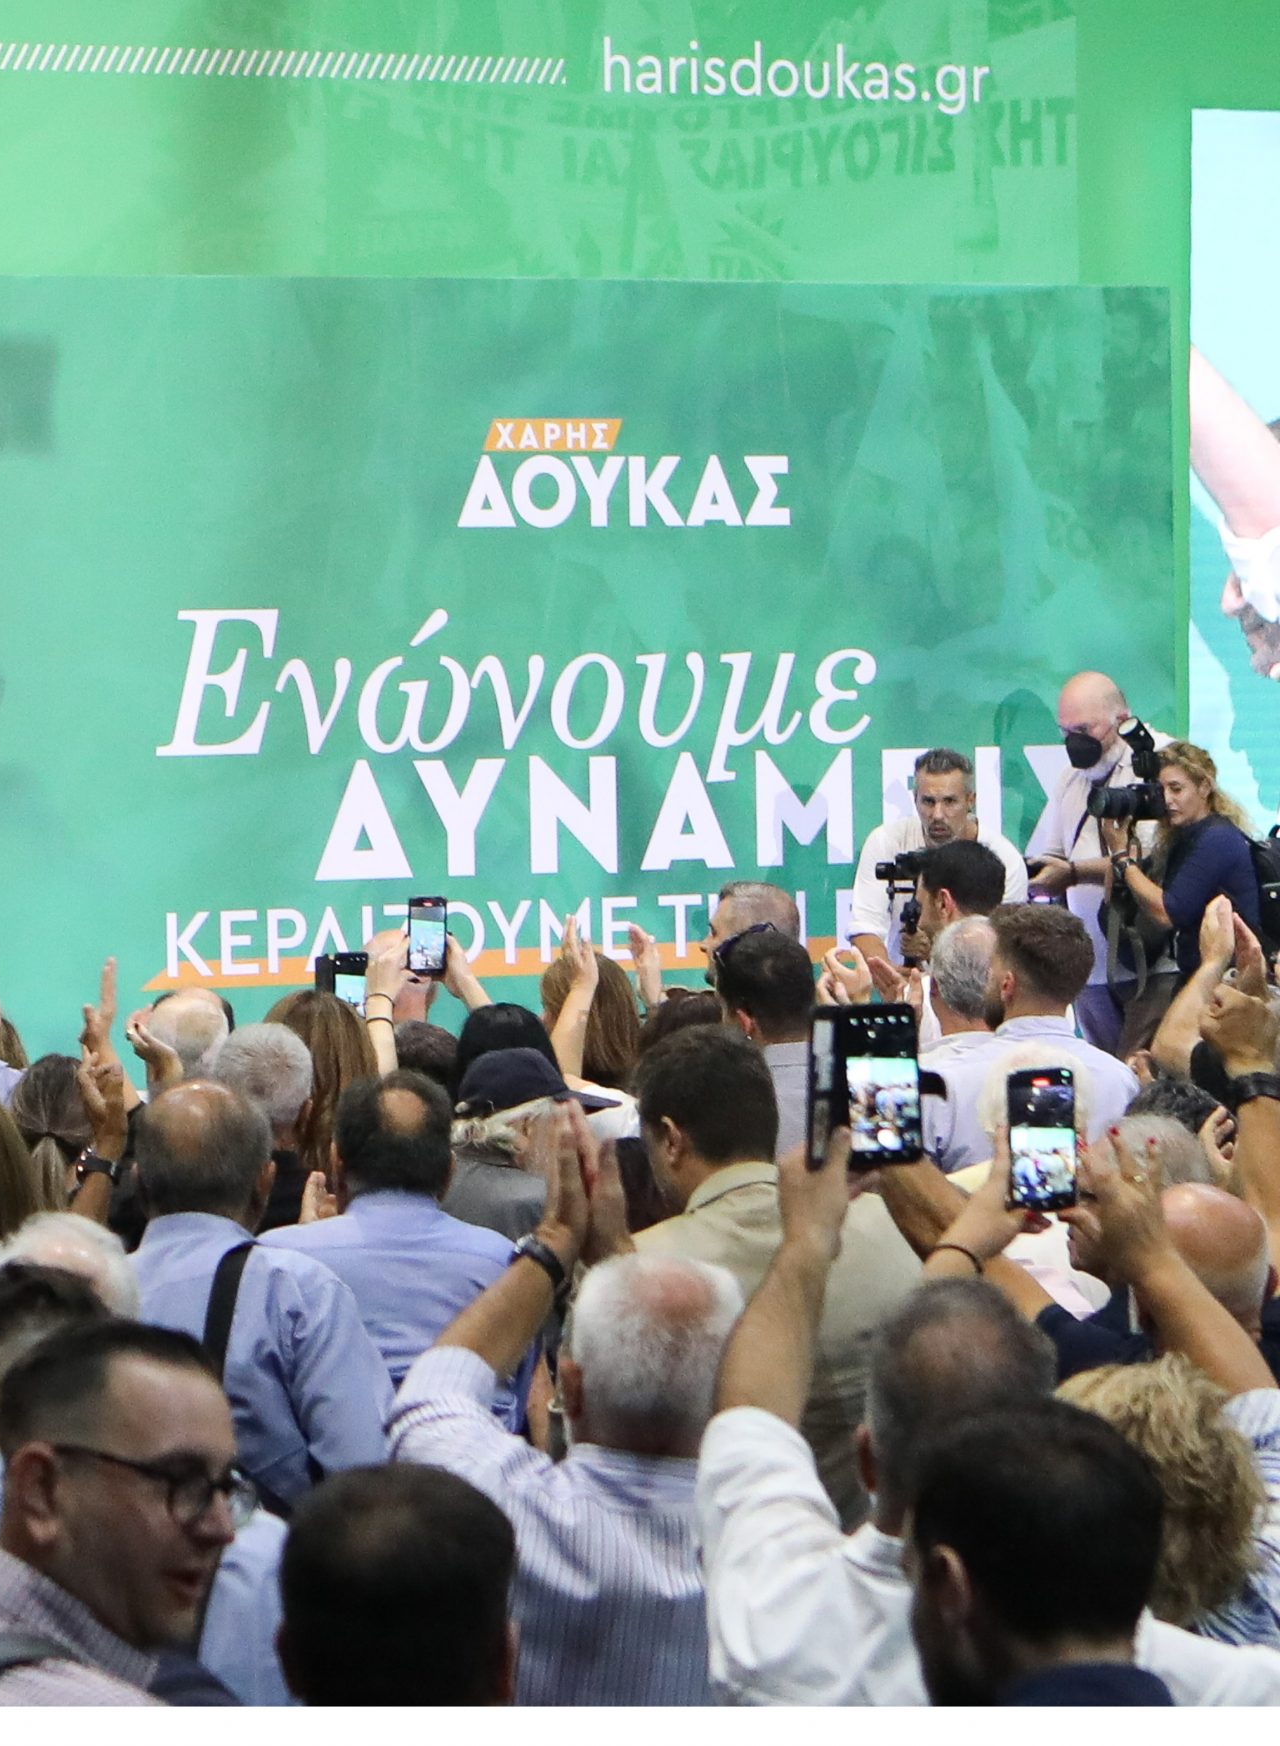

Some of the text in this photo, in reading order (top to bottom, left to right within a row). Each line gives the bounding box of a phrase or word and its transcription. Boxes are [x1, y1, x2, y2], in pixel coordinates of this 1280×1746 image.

[602, 37, 991, 115] harisdoukas.gr
[496, 422, 609, 450] ΧΑΡΗΣ
[457, 454, 791, 528] ΔΟΥΚΑΣ
[155, 608, 877, 783] Ενώνουμε
[314, 744, 1067, 881] ΔΥΝΑΜΙ
